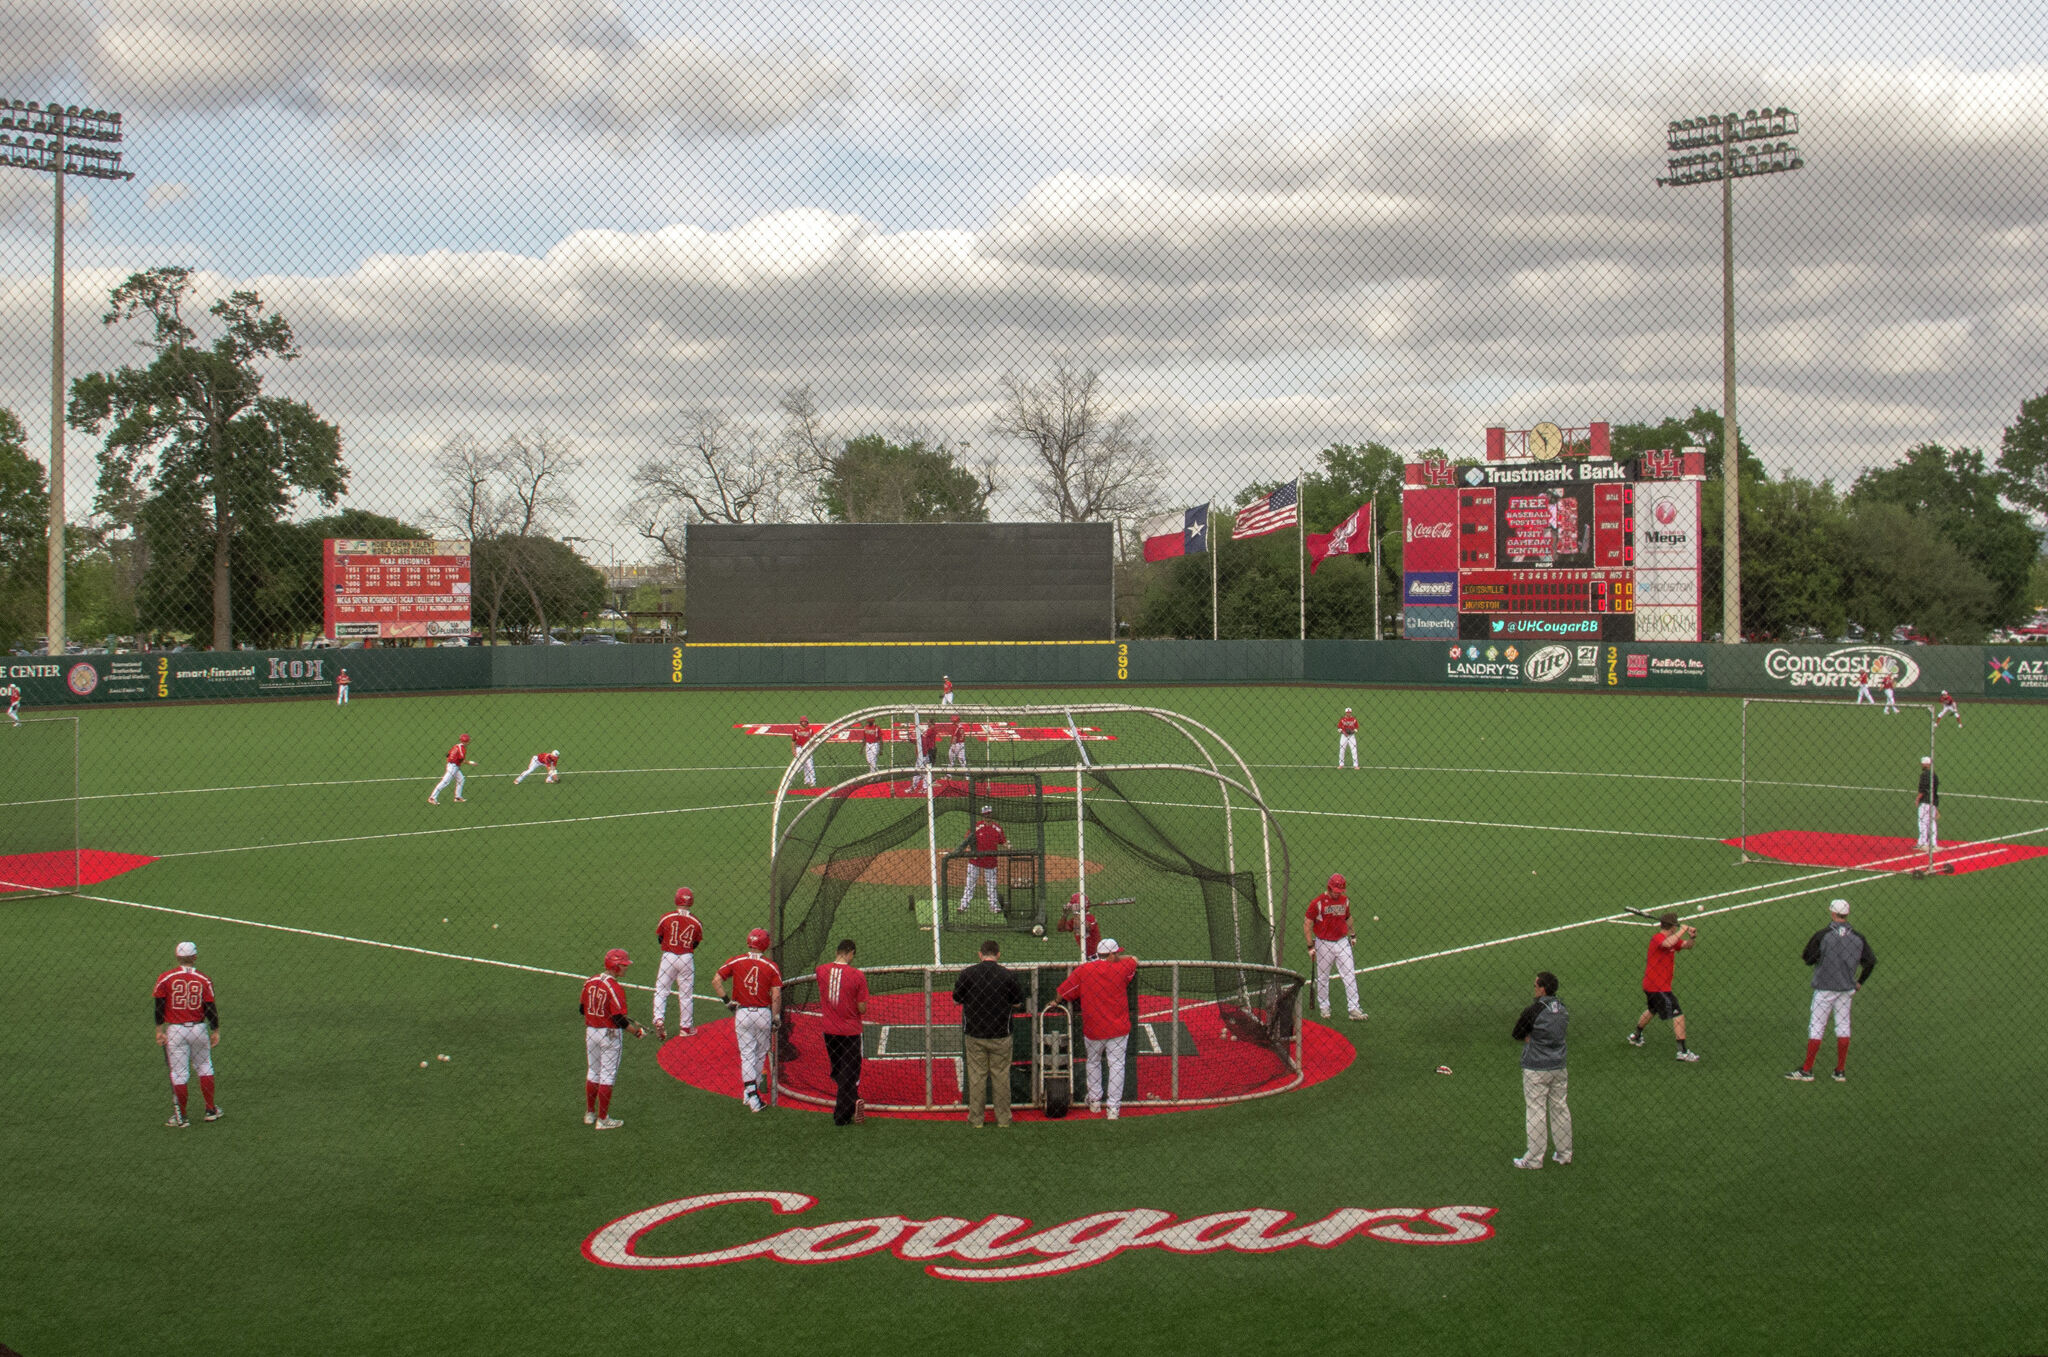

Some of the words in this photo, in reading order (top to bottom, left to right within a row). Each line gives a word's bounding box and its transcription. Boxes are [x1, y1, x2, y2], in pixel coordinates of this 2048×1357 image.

[1485, 464, 1573, 483] Trustmark
[1579, 461, 1626, 480] Bank
[1510, 498, 1547, 509] FREE
[1506, 511, 1551, 519] BASEBALL
[1516, 530, 1542, 538] VISIT
[1645, 530, 1687, 545] Mega
[1507, 538, 1552, 546] GAMEDAY
[1417, 618, 1456, 630] Insperity
[1507, 619, 1599, 635] @UHCougarBB
[9, 664, 61, 678] CENTER
[176, 669, 207, 679] smart
[210, 666, 255, 677] financial
[1447, 662, 1519, 676] LANDRY'S
[1532, 652, 1566, 679] Lite
[2017, 660, 2048, 674] AZ
[669, 920, 695, 949] 14
[743, 966, 759, 996] 4
[172, 979, 203, 1010] 28
[587, 985, 608, 1017] 17
[580, 1191, 1500, 1282] Cougars
